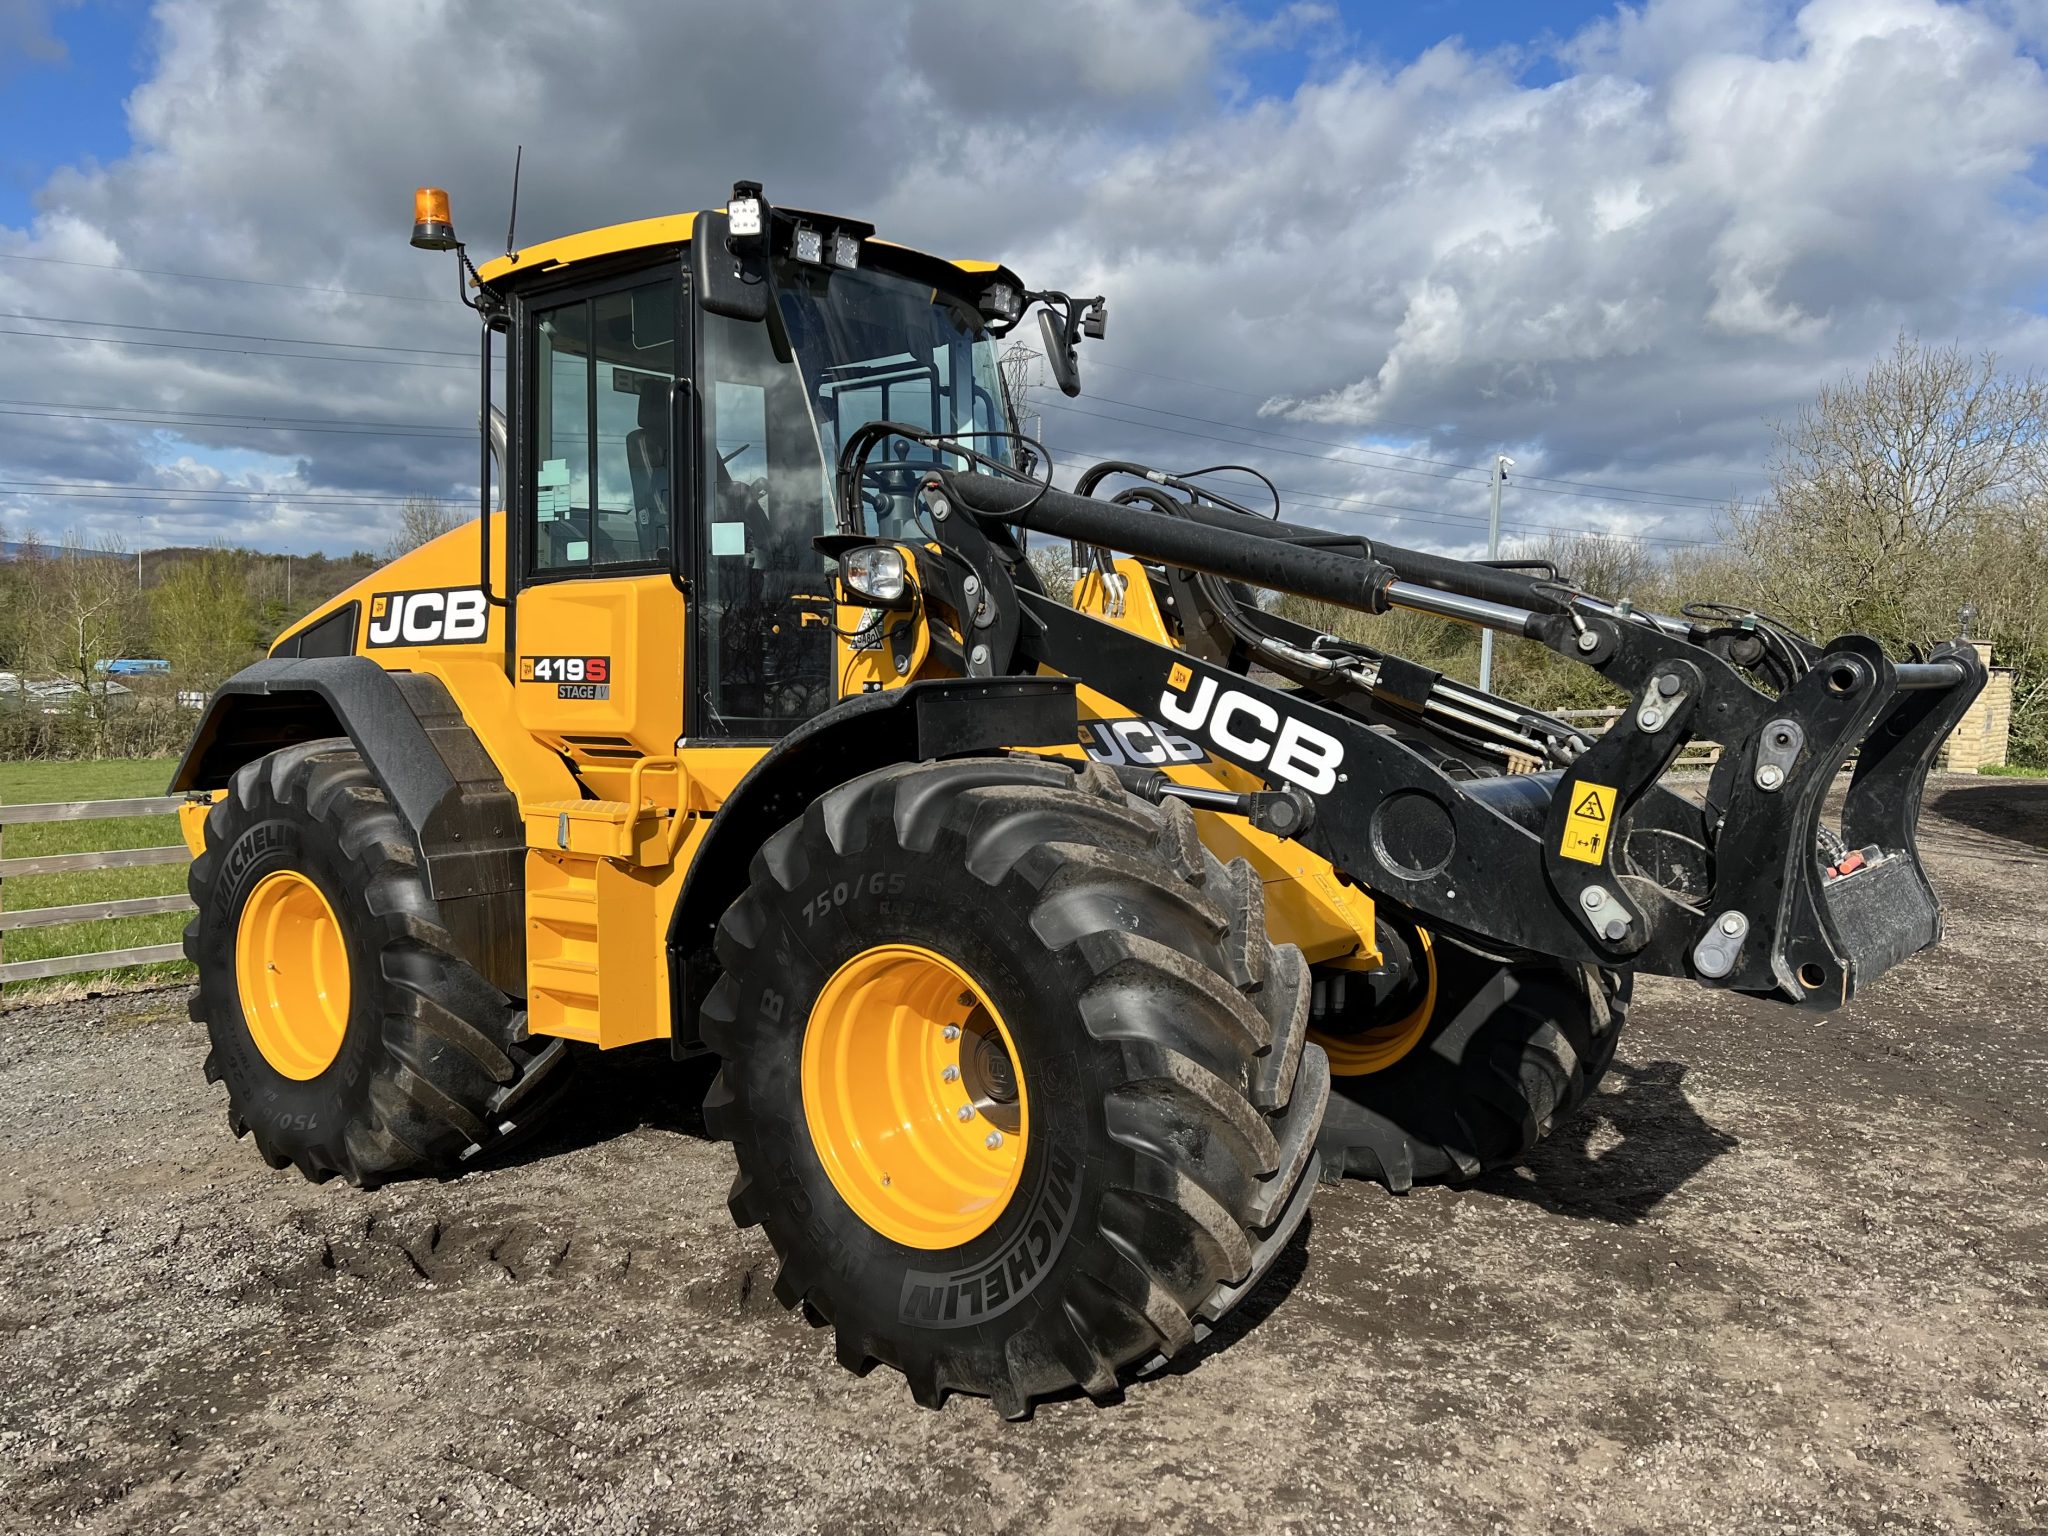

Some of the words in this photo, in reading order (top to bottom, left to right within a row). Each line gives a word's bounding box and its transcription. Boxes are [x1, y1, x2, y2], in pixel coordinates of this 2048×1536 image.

[370, 590, 486, 644] JCB
[534, 658, 607, 682] 419S
[559, 685, 595, 699] STAGE
[598, 685, 608, 699] V
[1087, 720, 1205, 765] JCB
[1159, 676, 1345, 796] JCB
[801, 872, 907, 928] 750/65
[903, 1144, 1078, 1321] MICHELIN
